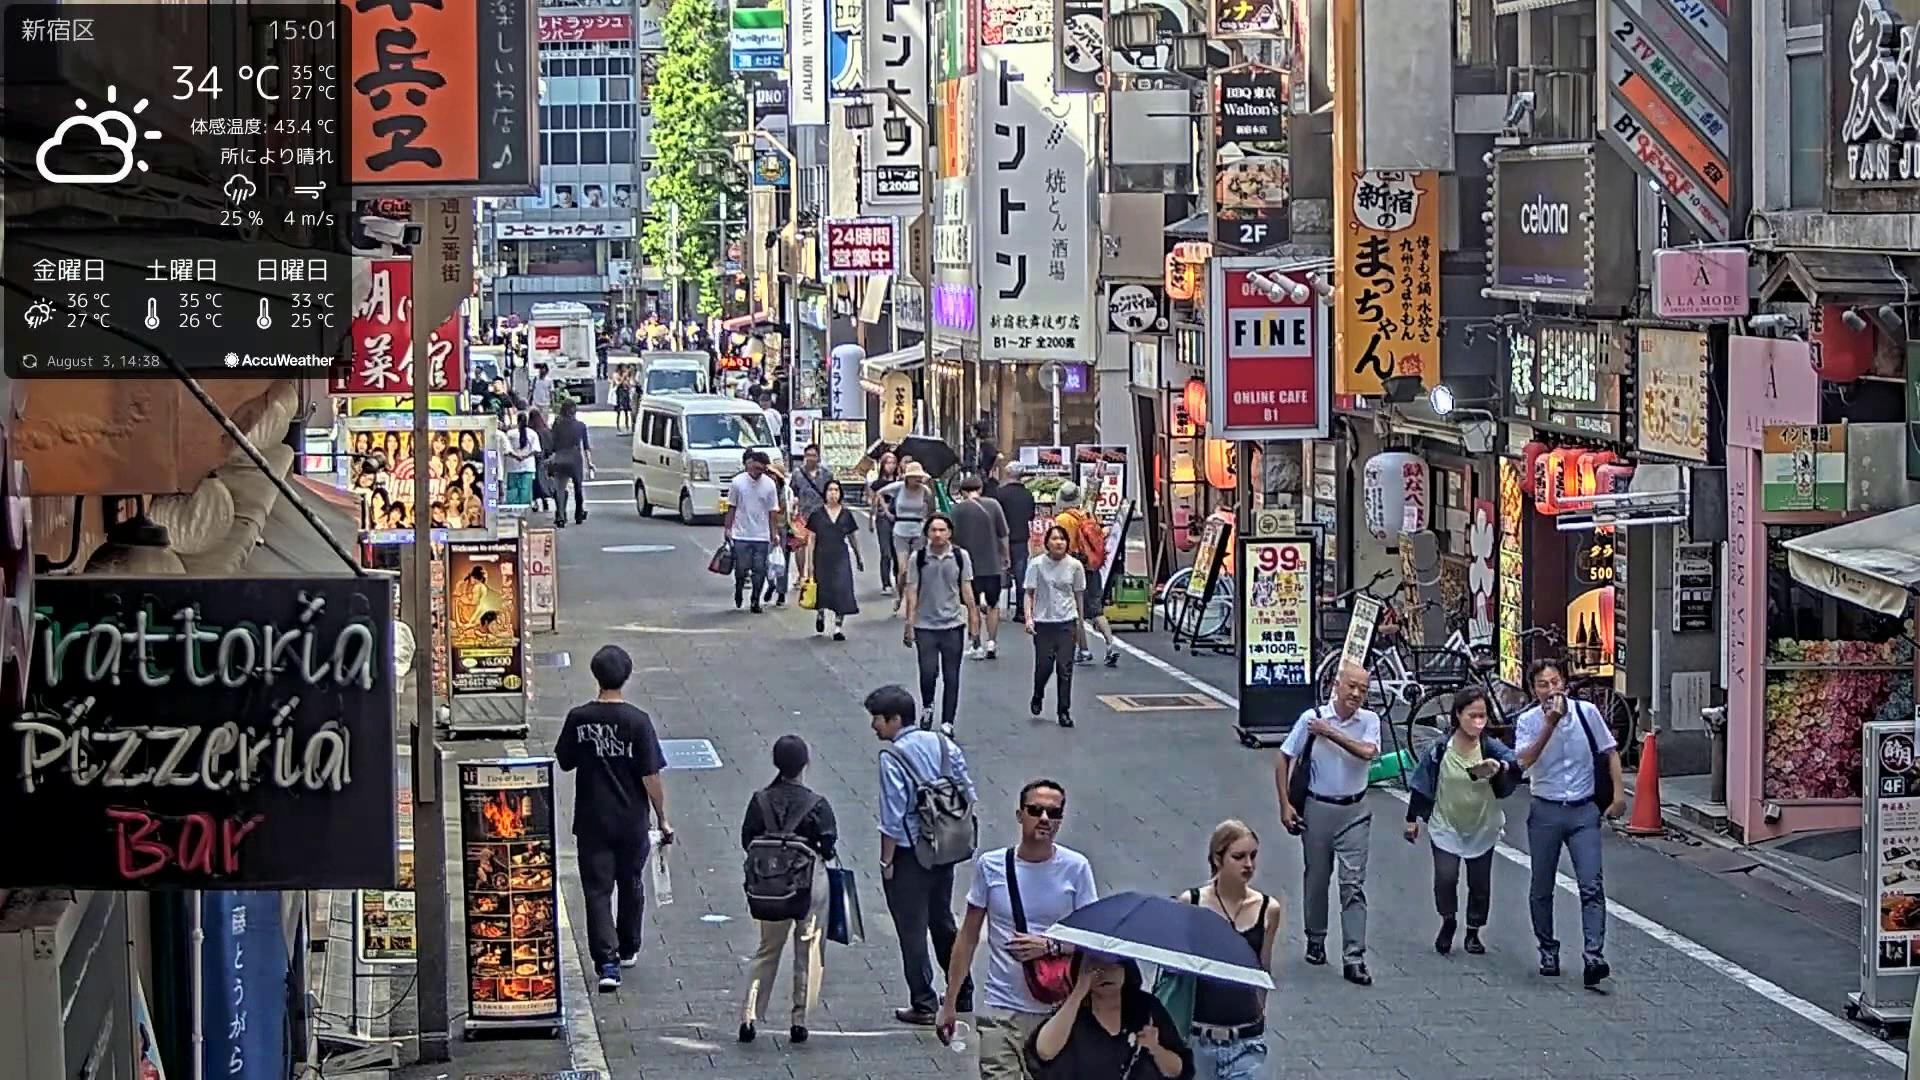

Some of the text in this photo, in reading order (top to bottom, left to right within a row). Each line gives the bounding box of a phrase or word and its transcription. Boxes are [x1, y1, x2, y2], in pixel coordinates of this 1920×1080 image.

[1615, 21, 1634, 42] 2
[1632, 36, 1655, 61] TV
[1618, 69, 1633, 87] 1
[1226, 87, 1251, 99] BBQ
[1224, 102, 1280, 117] Walton's
[1614, 113, 1641, 141] B1
[1848, 144, 1890, 181] TAN
[994, 59, 1027, 299] トントン
[1520, 194, 1569, 234] celona
[832, 227, 891, 246] 24時間
[1239, 224, 1269, 243] 2F
[832, 248, 890, 268] 営業中
[1354, 235, 1398, 380] まっちゃん
[1678, 296, 1694, 306] LA
[1700, 296, 1741, 306] MODE
[1235, 316, 1306, 346] FINE
[831, 356, 843, 418] カラオケ
[1233, 390, 1308, 404] ONLINE CAFE
[1590, 567, 1613, 579] 500
[35, 590, 378, 692] rattoria
[1261, 631, 1296, 642] 焼き鳥
[12, 695, 354, 794] Pizzeria
[1883, 778, 1902, 793] 4F
[106, 805, 265, 880] Bar
